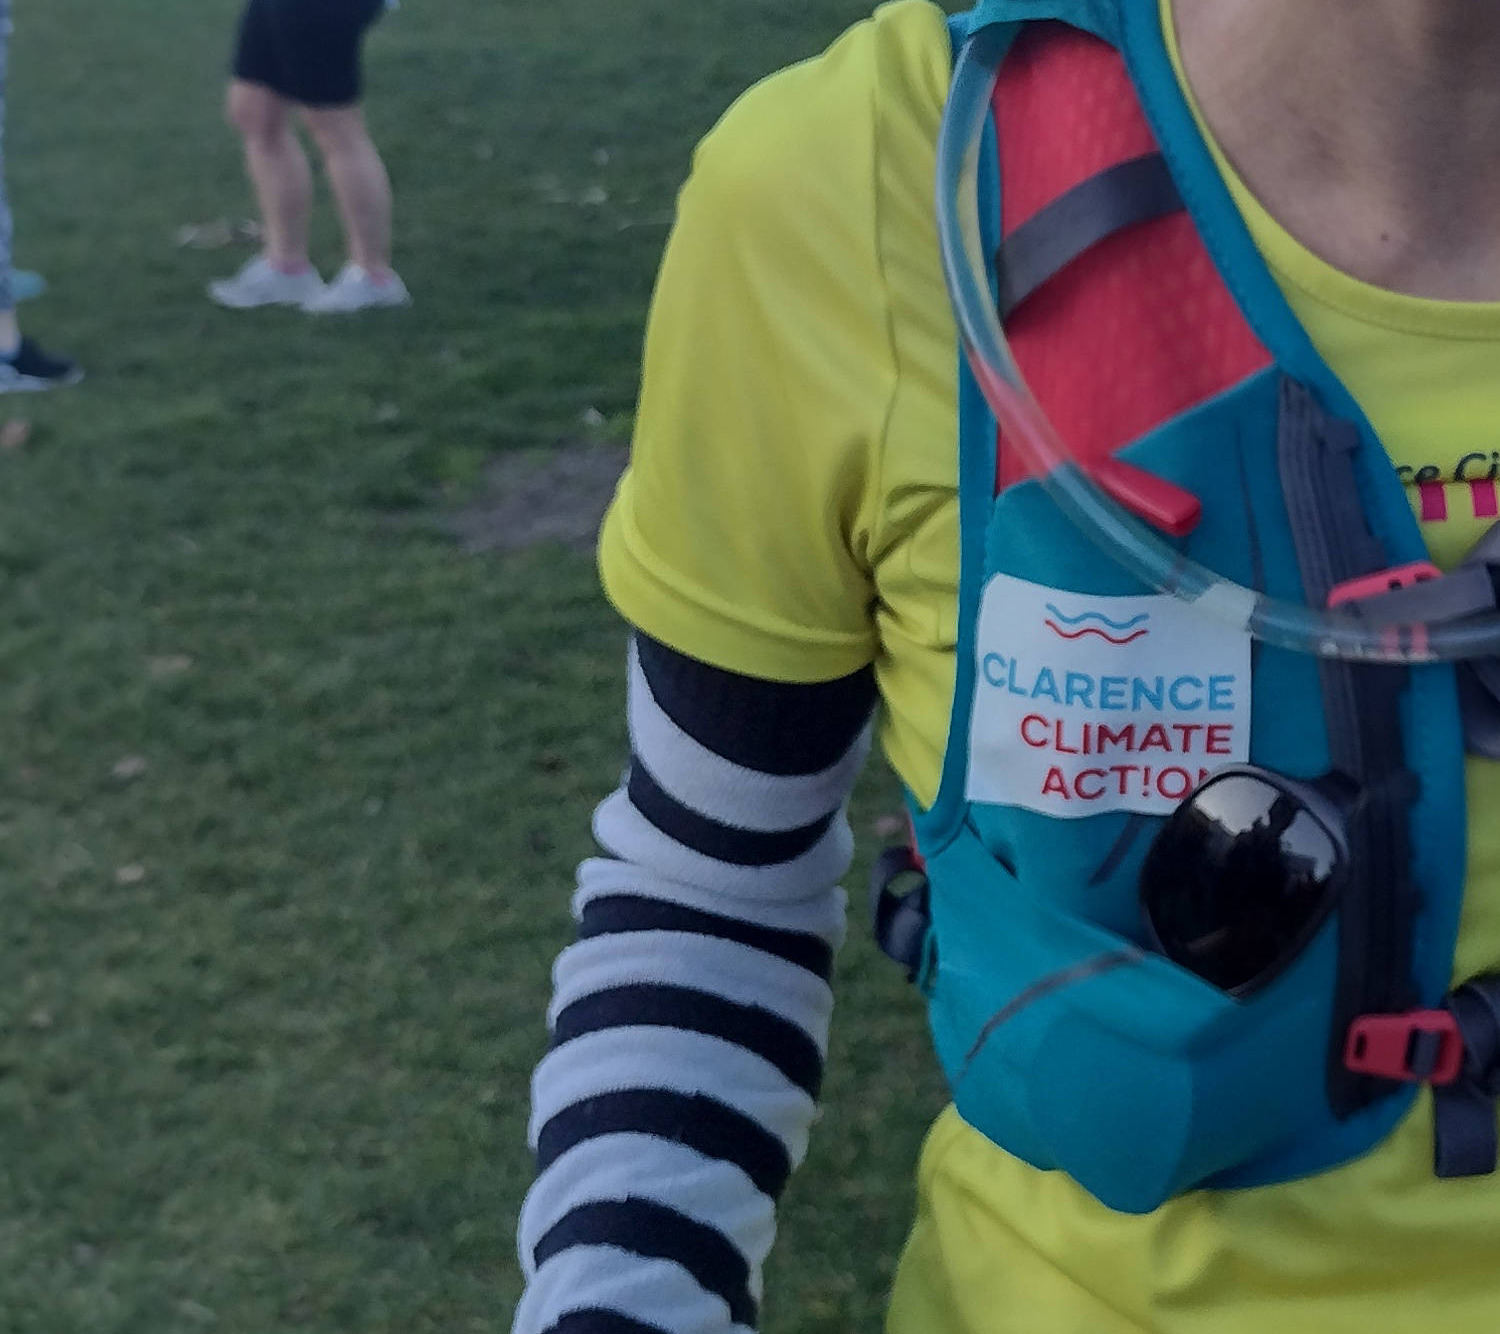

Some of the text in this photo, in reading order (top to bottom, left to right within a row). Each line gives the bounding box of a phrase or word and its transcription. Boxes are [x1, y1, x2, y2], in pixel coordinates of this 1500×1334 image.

[982, 652, 1235, 711] CLARENCE
[1020, 714, 1234, 755] CLIMATE
[1041, 764, 1209, 800] ACT!O
